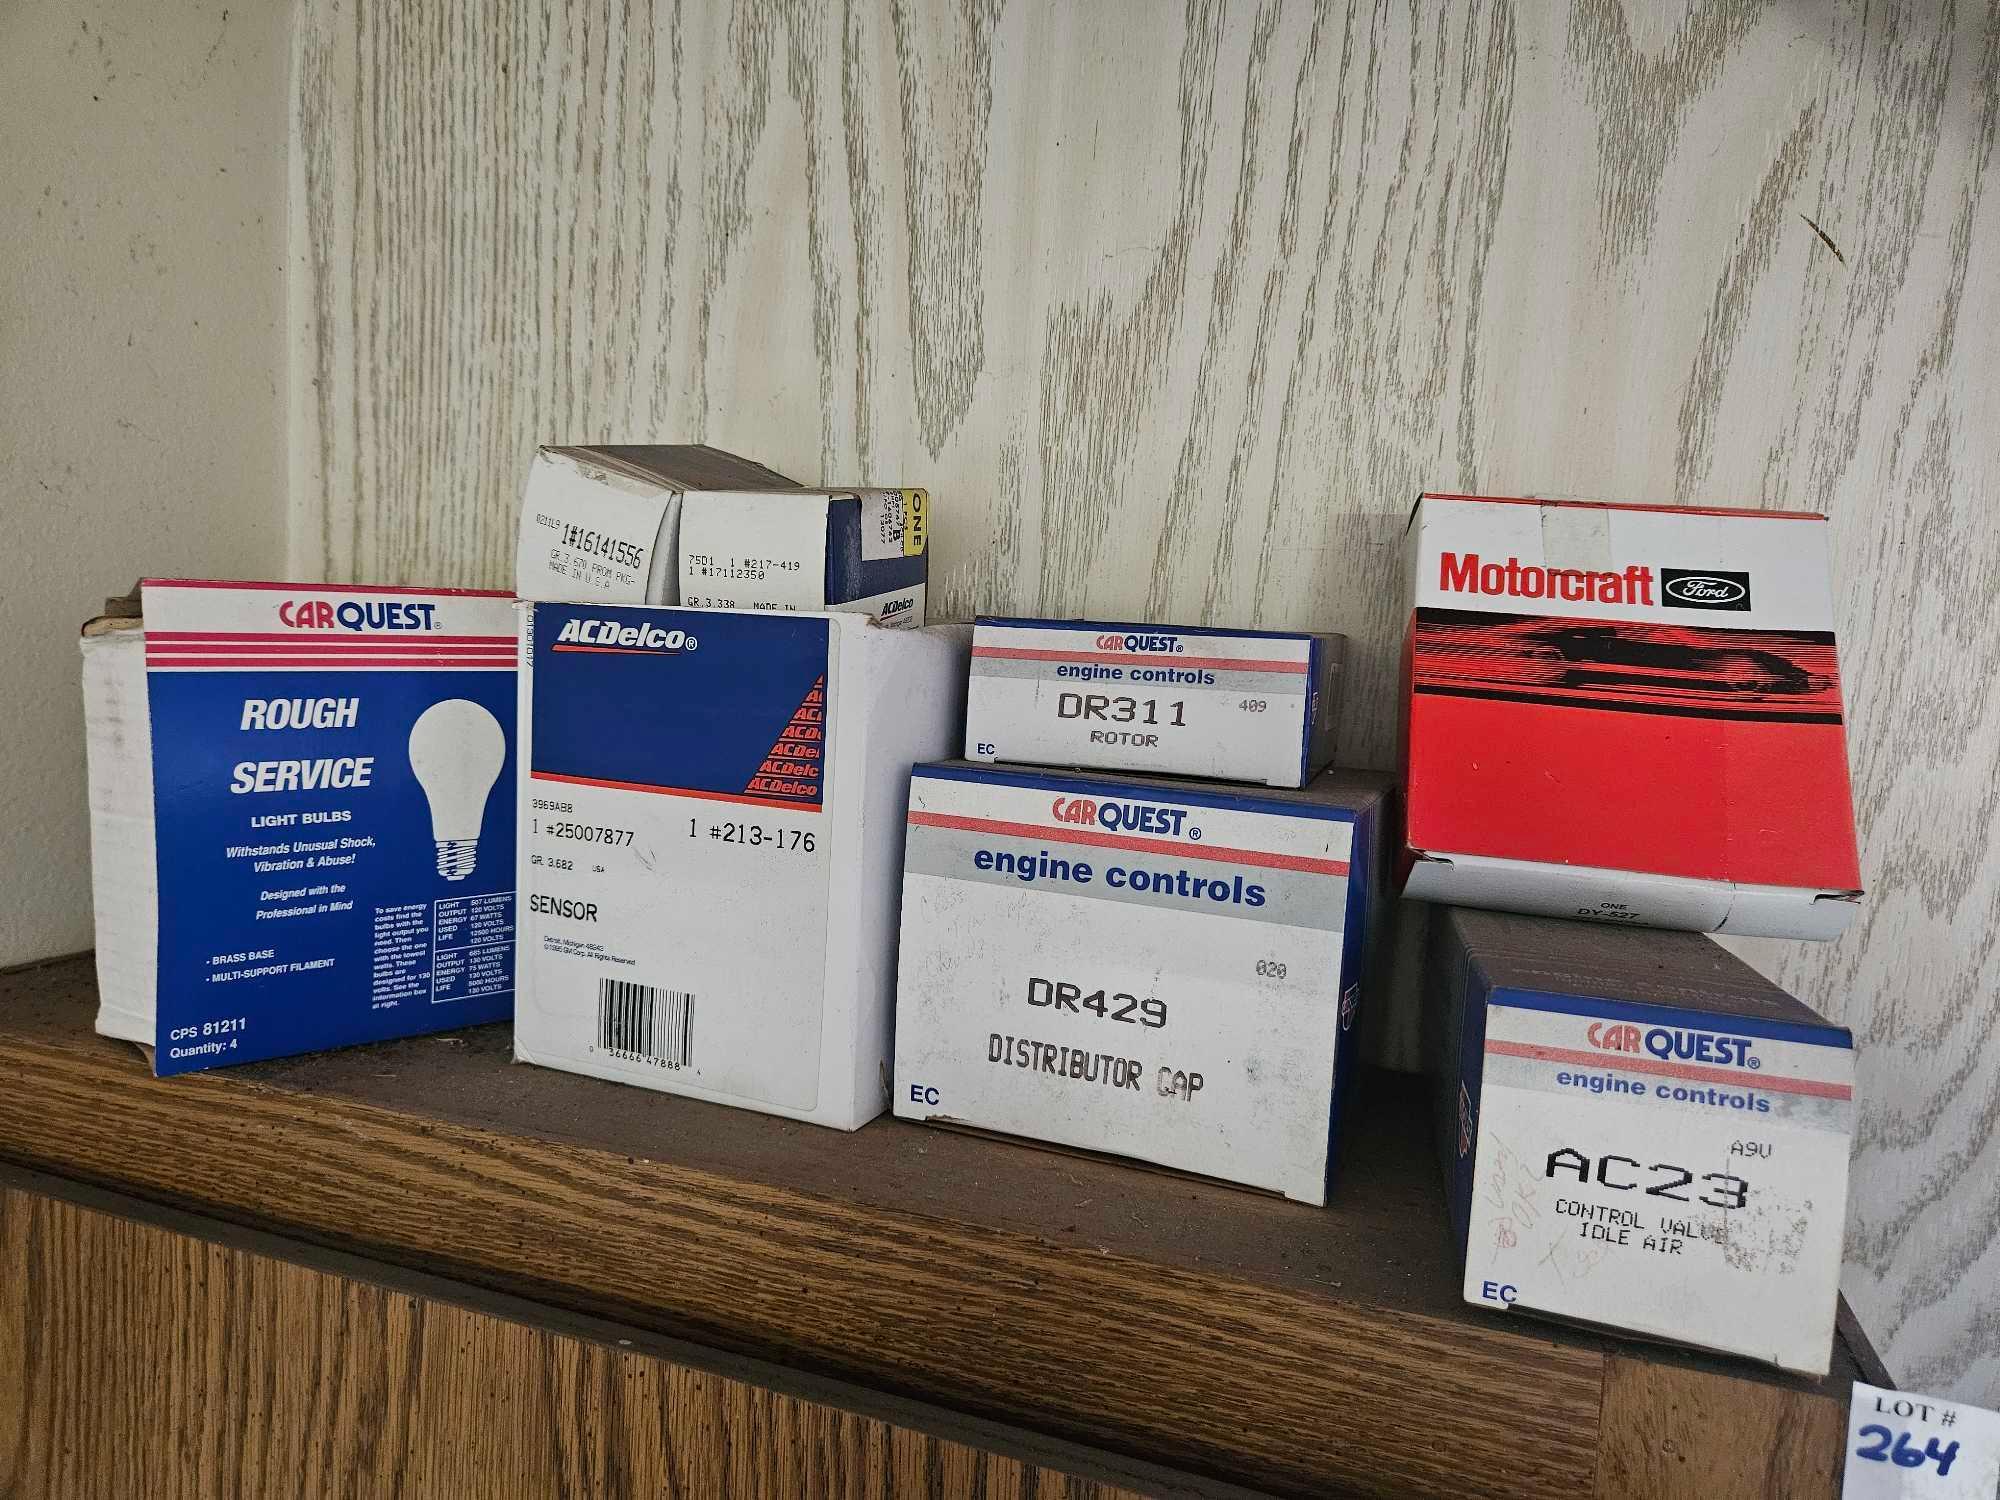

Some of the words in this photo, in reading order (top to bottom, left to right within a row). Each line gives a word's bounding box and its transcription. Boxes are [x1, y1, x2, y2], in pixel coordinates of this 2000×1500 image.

[913, 493, 922, 546] ONE
[689, 566, 694, 576] 1
[702, 567, 765, 580] #17112350
[731, 557, 735, 567] 1
[744, 558, 800, 571] #217-419
[1439, 552, 1655, 606] Motorcraft
[1683, 580, 1728, 598] Ford
[881, 598, 913, 616] ACDelco
[1056, 663, 1123, 682] engine
[1130, 665, 1215, 686] controls
[240, 697, 359, 730] ROUGH
[1057, 692, 1187, 727] DR311
[1238, 699, 1267, 714] 409
[1089, 730, 1159, 748] ROTOR
[977, 743, 996, 756] EC
[230, 757, 374, 794] SERVICE
[747, 777, 817, 795] ACDelco
[251, 813, 298, 829] LIGHT
[302, 810, 352, 825] BULBS
[533, 818, 538, 834] 1
[546, 821, 634, 847] #25007877
[688, 818, 697, 838] 1
[709, 822, 816, 852] #213-176
[226, 842, 290, 859] Withstands
[293, 838, 338, 853] Unusual
[340, 835, 376, 849] Shock,
[254, 858, 303, 873] Vibration
[306, 857, 315, 868] &
[317, 854, 356, 867] Abuse!
[547, 857, 573, 871] 3.682
[974, 847, 1093, 883] engine
[1105, 867, 1266, 907] controls
[260, 887, 307, 902] Designed
[308, 884, 329, 896] with
[331, 883, 346, 894] the
[484, 896, 513, 904] LUMENS
[256, 904, 317, 920] Professional
[318, 902, 328, 913] in
[330, 900, 353, 912] Mind
[438, 901, 460, 910] LIGHT
[438, 908, 467, 918] OUTPUT
[483, 904, 505, 912] VOLTS
[530, 894, 598, 923] SENSOR
[438, 916, 468, 926] ENERGY
[479, 912, 503, 920] WATTS
[483, 919, 504, 927] VOLTS
[416, 927, 429, 935] you
[438, 925, 458, 933] USED
[438, 933, 454, 941] LIFE
[482, 934, 505, 942] VOLTS
[490, 925, 514, 933] HOURS
[212, 952, 247, 966] BRASS
[249, 949, 275, 961] BASE
[436, 952, 458, 961] LIGHT
[436, 959, 466, 969] OUTPUT
[612, 955, 635, 966] Reserved
[212, 965, 289, 983] MULTI-SUPPORT
[290, 958, 335, 972] FILAMENT
[436, 966, 466, 976] ENERGY
[436, 975, 456, 984] USED
[435, 984, 452, 992] LIFE
[1027, 976, 1169, 1029] DR429
[170, 1026, 198, 1041] CPS
[203, 1017, 246, 1036] 81211
[170, 1041, 227, 1059] Quantity:
[230, 1038, 238, 1049] 4
[988, 1032, 1142, 1092] DISTRIBUTOR
[1156, 1065, 1204, 1103] CAP
[910, 1084, 940, 1106] EC
[1556, 1071, 1646, 1095] engine
[1655, 1084, 1770, 1113] controls
[1546, 1147, 1749, 1210] AC23
[1555, 1199, 1645, 1231] CONTROL
[1579, 1223, 1630, 1246] IDLE
[1643, 1237, 1684, 1256] AIR
[1482, 1280, 1519, 1304] EC
[1875, 1396, 1935, 1423] LOT
[1940, 1409, 1957, 1428] #
[1856, 1424, 1960, 1477] 264
